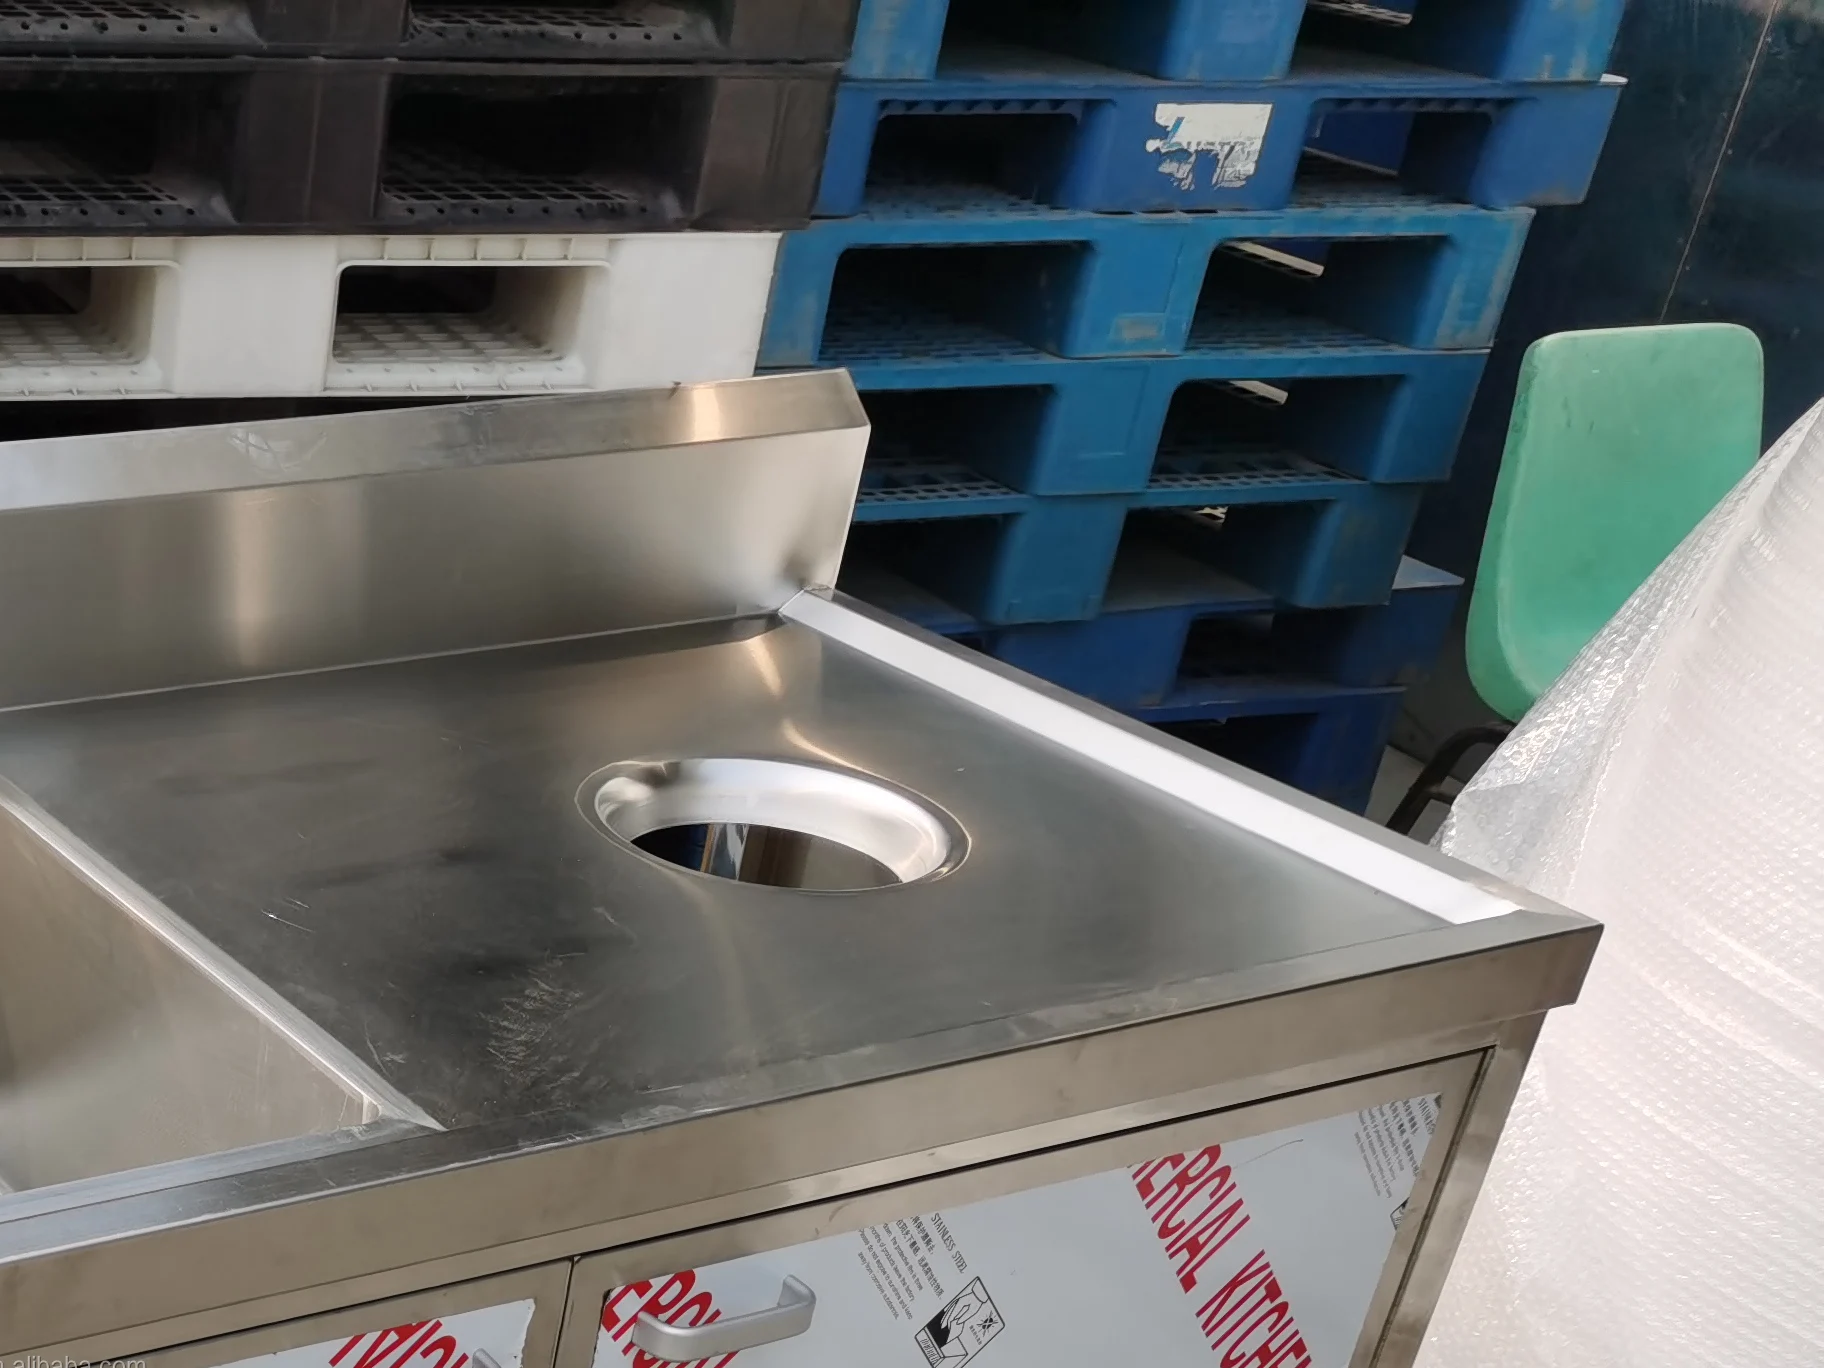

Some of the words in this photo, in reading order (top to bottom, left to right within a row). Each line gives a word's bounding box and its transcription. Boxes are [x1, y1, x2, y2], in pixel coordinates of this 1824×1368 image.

[931, 1212, 956, 1251] STAINLESS
[951, 1250, 967, 1274] STEEL
[1132, 1144, 1251, 1294] ERCIAL
